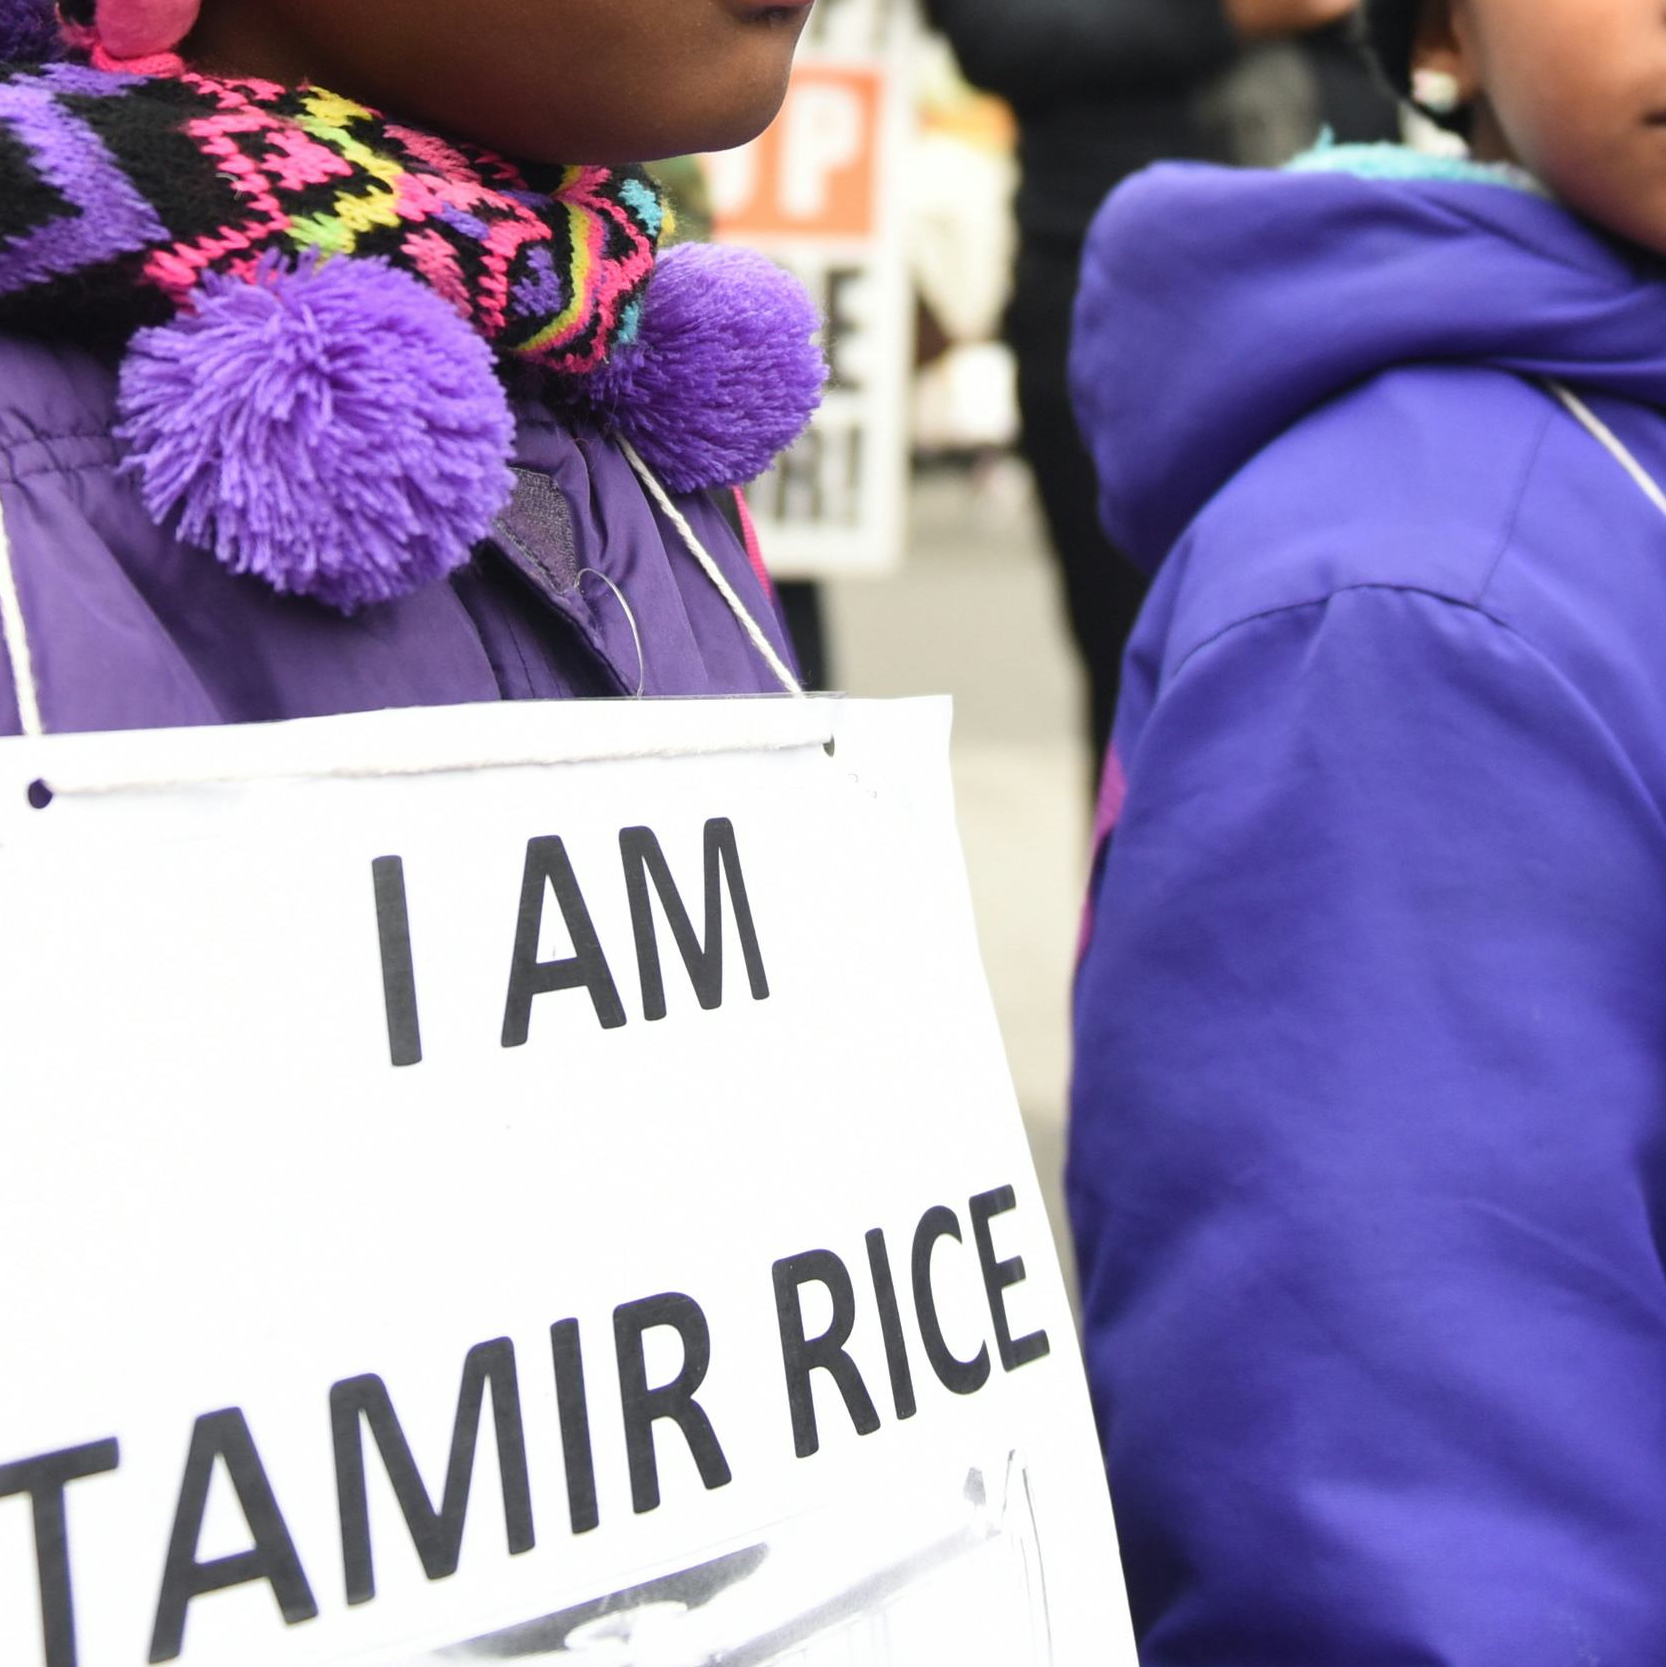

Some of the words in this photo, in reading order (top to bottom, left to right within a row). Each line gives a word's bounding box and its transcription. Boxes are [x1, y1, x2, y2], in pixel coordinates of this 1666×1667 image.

[371, 855, 423, 1067] I
[500, 817, 770, 1048] AM
[770, 1184, 1051, 1460] RICE
